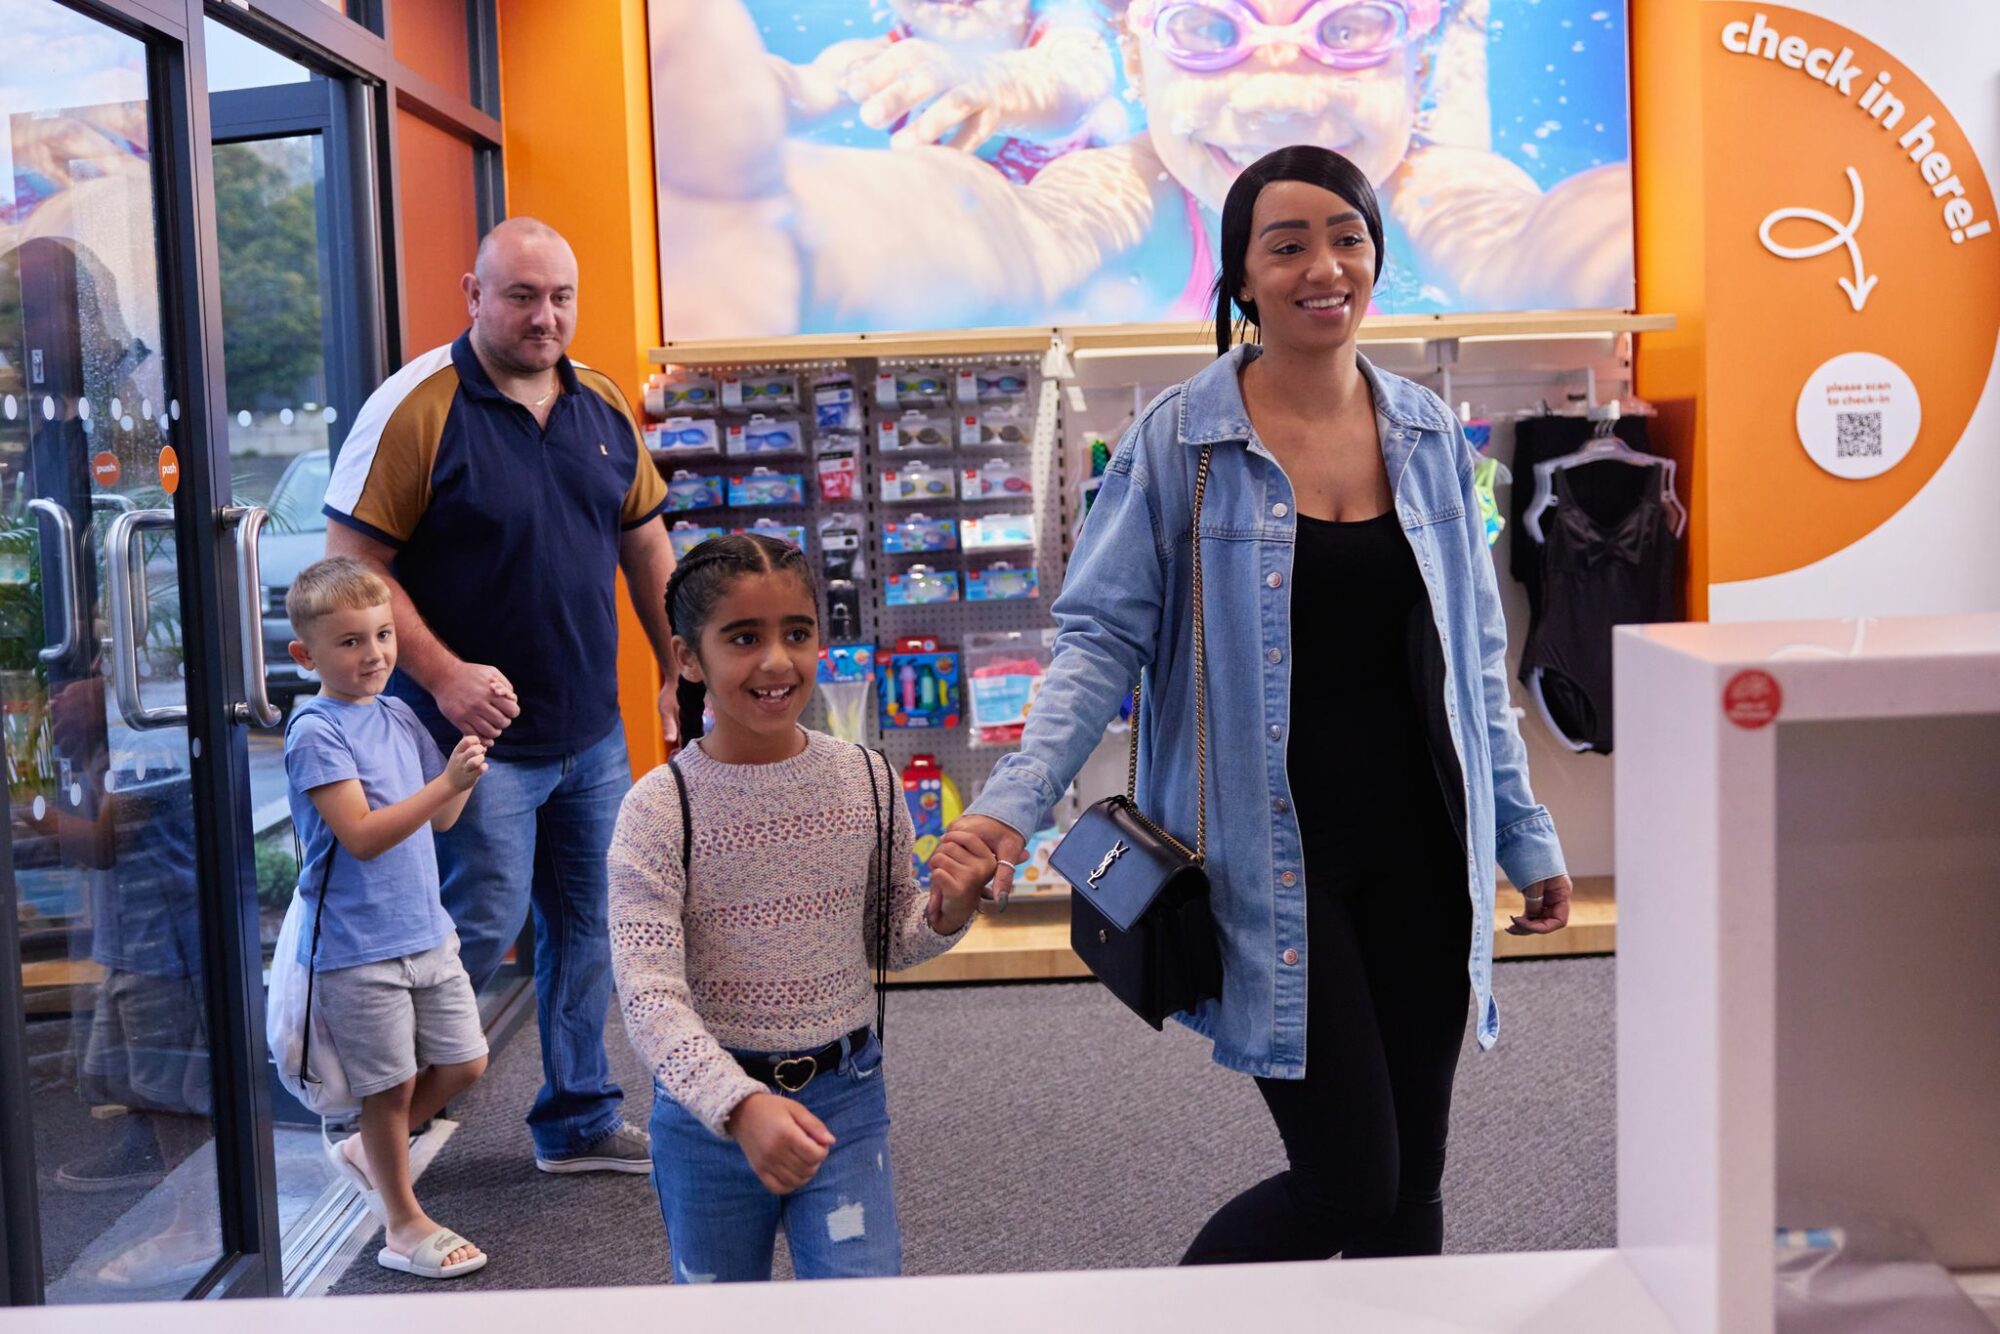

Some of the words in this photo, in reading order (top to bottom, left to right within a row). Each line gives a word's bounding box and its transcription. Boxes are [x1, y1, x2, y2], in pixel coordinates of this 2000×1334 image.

[1721, 13, 1862, 97] check
[1858, 70, 1906, 131] in
[1898, 115, 1992, 244] here!
[1826, 382, 1861, 394] please
[1865, 382, 1891, 391] scan
[1828, 397, 1839, 406] to
[1842, 395, 1890, 405] check-in
[96, 463, 117, 475] push
[162, 462, 177, 478] push
